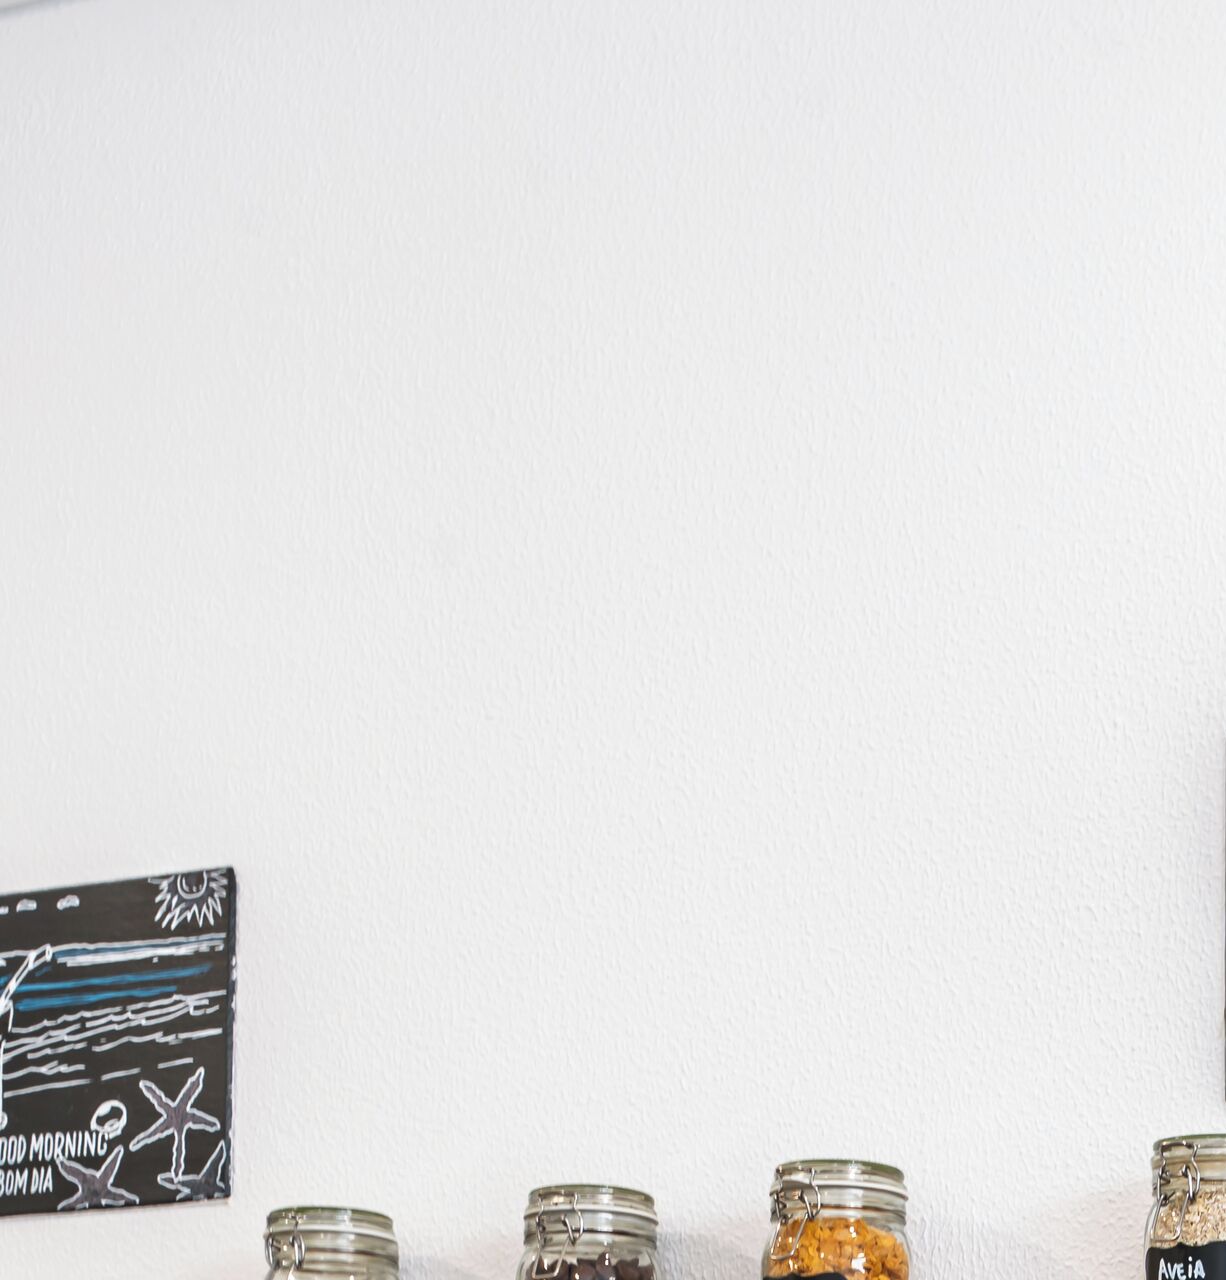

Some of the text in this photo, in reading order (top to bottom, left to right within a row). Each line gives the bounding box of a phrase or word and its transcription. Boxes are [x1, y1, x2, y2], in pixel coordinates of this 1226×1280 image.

[0, 1130, 108, 1166] OOD MORNING
[31, 1165, 53, 1194] DIA
